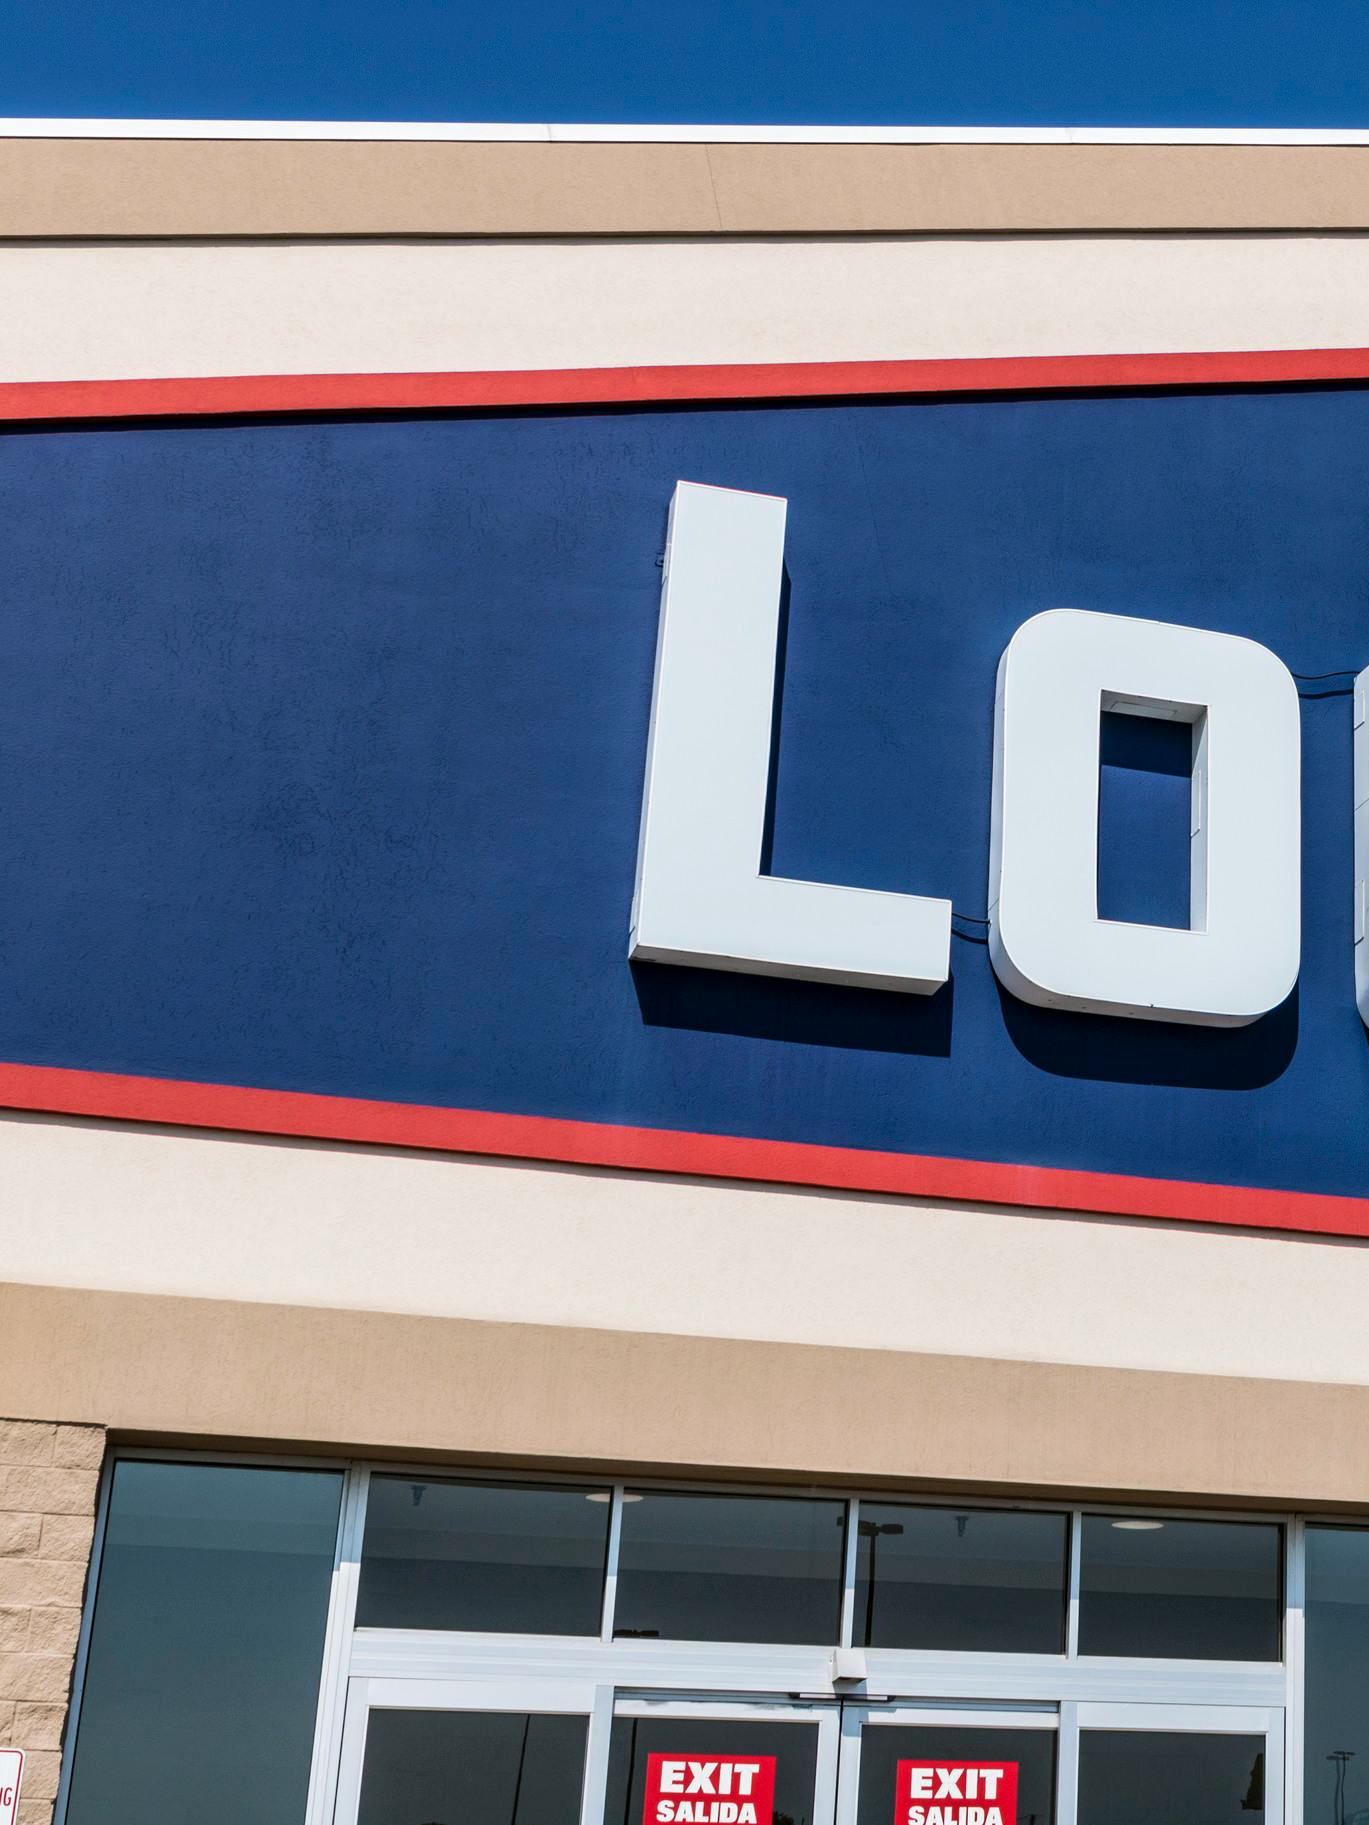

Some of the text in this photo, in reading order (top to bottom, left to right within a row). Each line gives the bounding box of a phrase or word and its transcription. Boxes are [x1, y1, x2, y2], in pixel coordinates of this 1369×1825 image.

[659, 1760, 760, 1796] EXIT
[910, 1767, 1004, 1800] EXIT
[656, 1798, 758, 1824] SALIDA
[907, 1805, 1004, 1825] SALIDA
